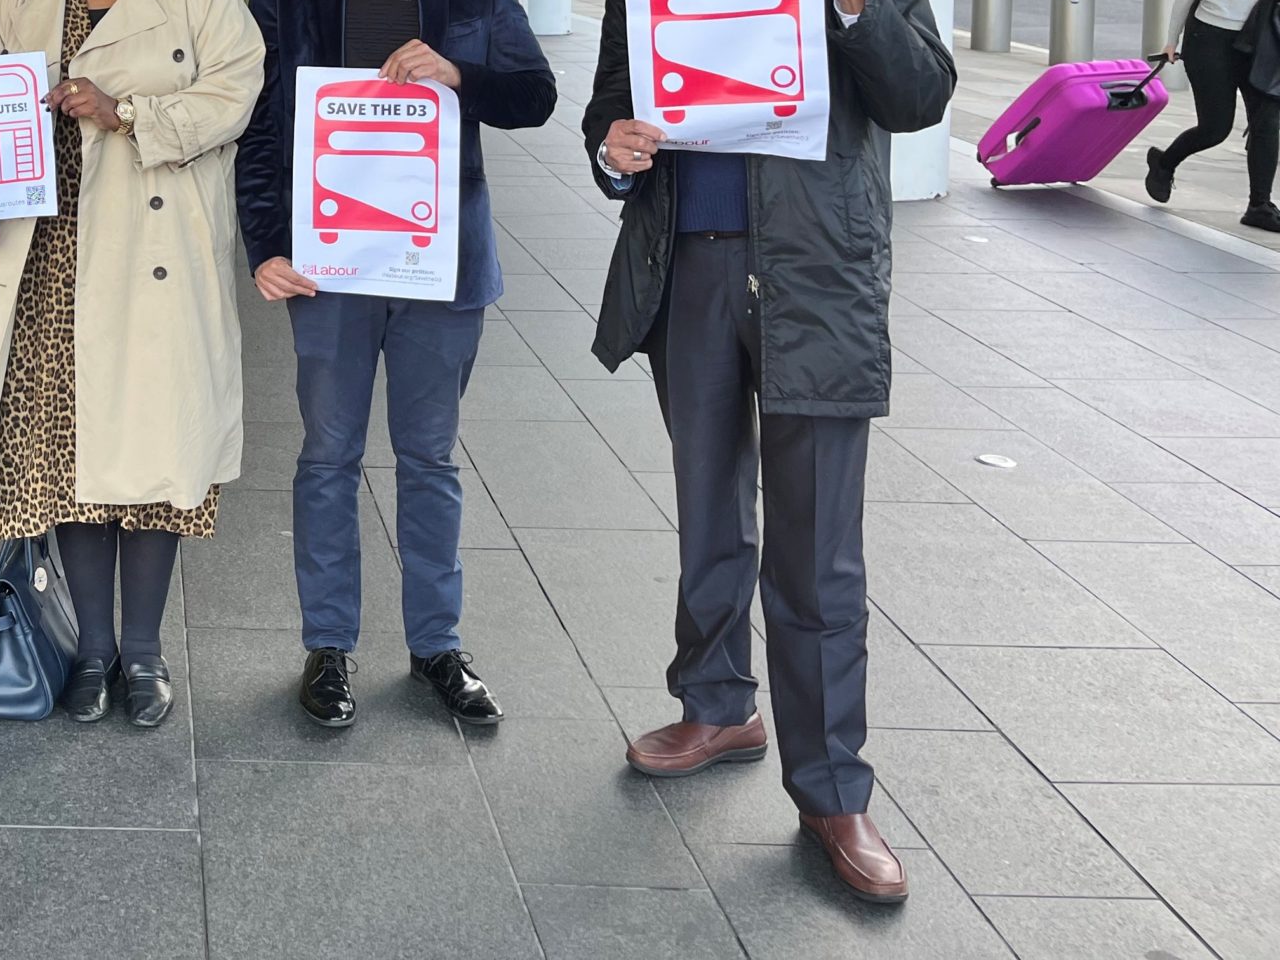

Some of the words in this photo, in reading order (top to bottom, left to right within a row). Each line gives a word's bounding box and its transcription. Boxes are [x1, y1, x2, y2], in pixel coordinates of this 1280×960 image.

[326, 102, 367, 116] SAVE
[370, 103, 401, 116] THE
[406, 104, 427, 117] D3
[314, 264, 360, 276] Labour
